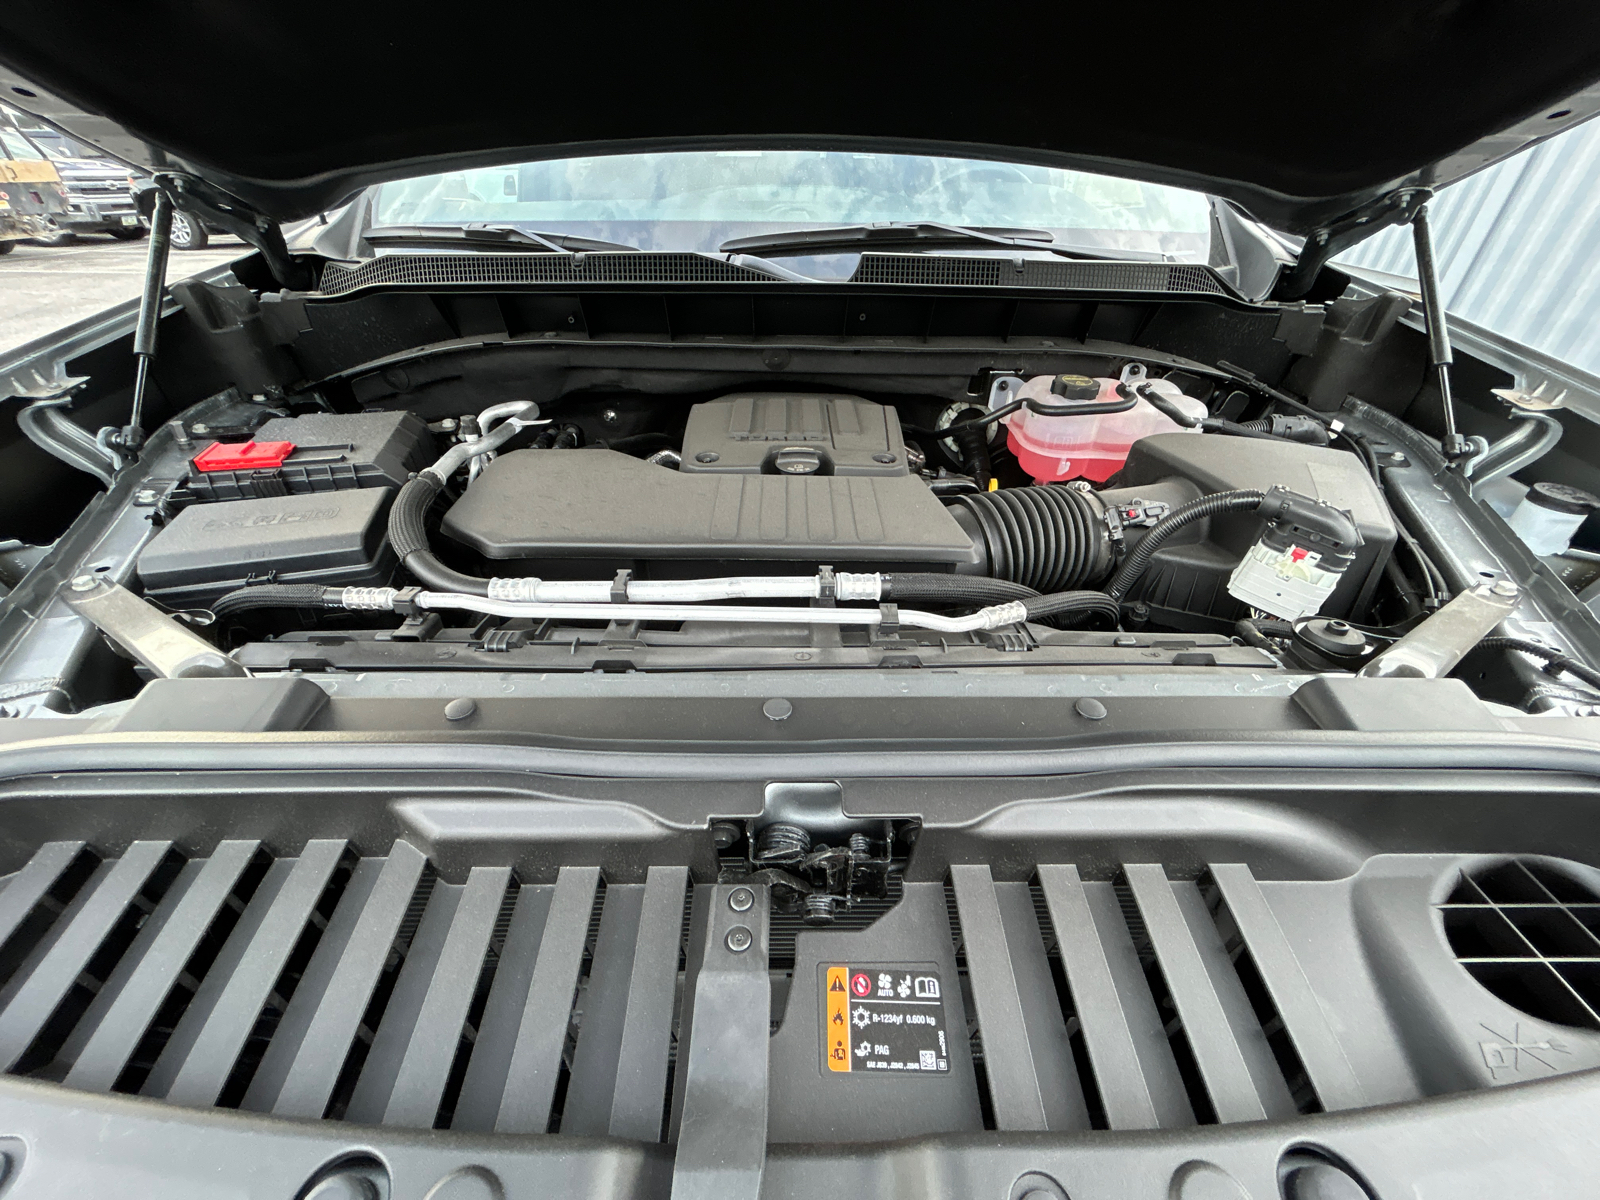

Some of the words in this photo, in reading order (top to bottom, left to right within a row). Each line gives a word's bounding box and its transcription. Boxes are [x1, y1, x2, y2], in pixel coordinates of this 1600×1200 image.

[878, 989, 894, 997] AUTO
[872, 1013, 903, 1025] R-1234yf
[906, 1014, 925, 1024] 0.600
[926, 1015, 936, 1026] kg
[874, 1045, 889, 1055] PAG
